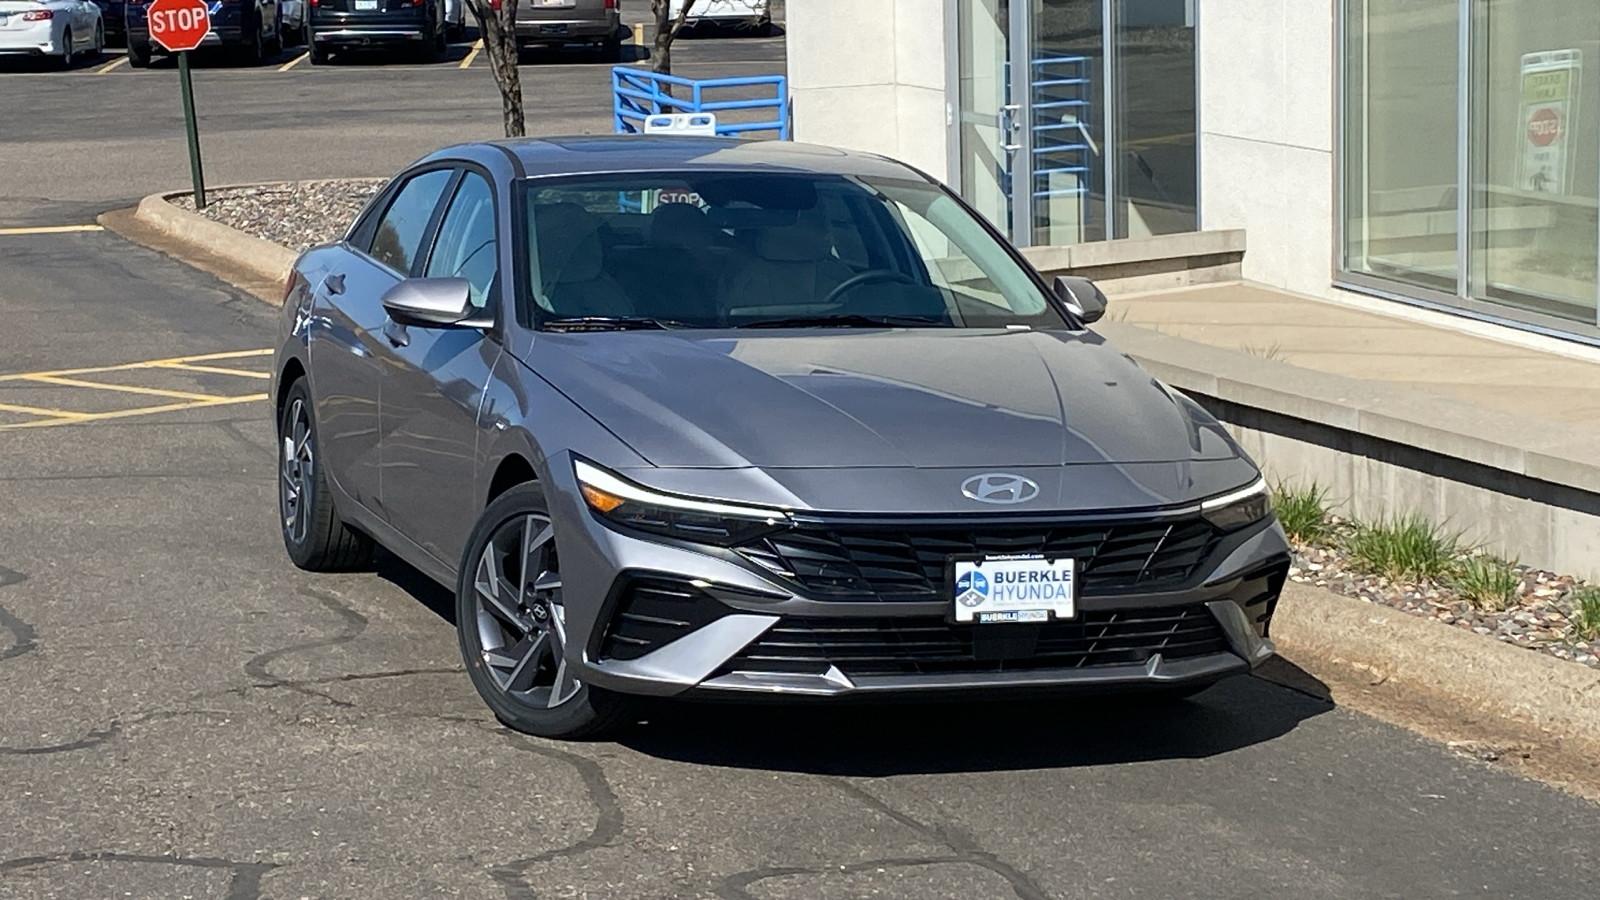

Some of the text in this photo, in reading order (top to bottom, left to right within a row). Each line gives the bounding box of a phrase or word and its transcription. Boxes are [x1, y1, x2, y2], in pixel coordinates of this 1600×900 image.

[152, 7, 206, 33] STOP
[994, 570, 1071, 583] BUERKLE
[993, 583, 1072, 601] HYUNDAI
